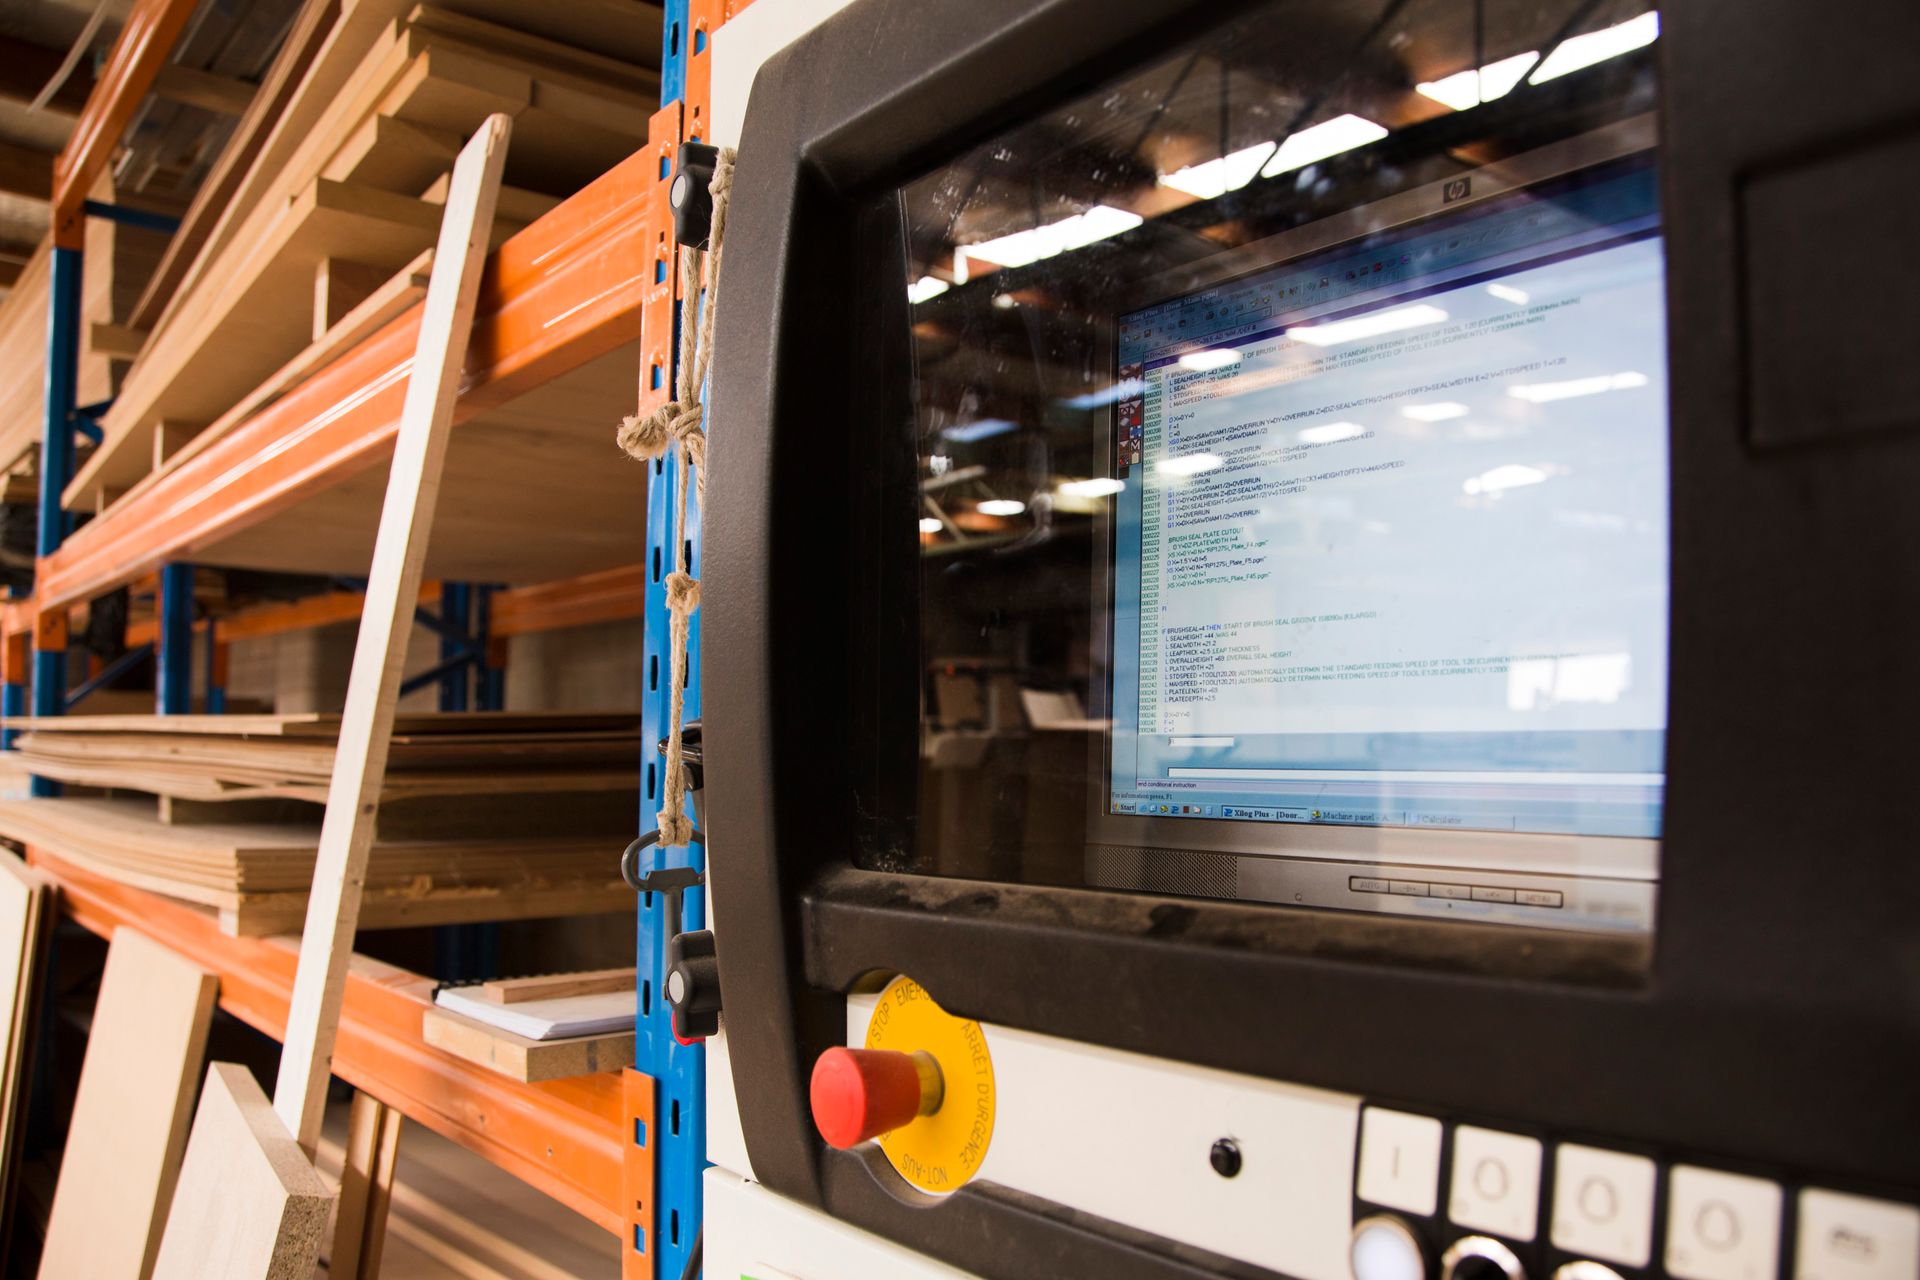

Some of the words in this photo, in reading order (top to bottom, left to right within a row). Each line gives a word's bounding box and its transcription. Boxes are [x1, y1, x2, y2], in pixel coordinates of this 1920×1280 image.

[1174, 371, 1206, 384] SEALHEIGHT
[1203, 530, 1220, 538] PLATE
[1221, 527, 1244, 536] CUTOUT
[1170, 641, 1201, 649] SEALWIDTH
[1228, 645, 1261, 653] THICKNESS
[1170, 656, 1213, 664] OVERALLHEIGHT
[1288, 666, 1320, 674] DETERMIN
[1336, 664, 1372, 672] STANDARD
[1374, 662, 1403, 670] FEEDING
[1441, 659, 1460, 667] TOOL
[1121, 803, 1134, 812] Start
[1235, 809, 1252, 819] Xilog
[1254, 809, 1269, 819] Plus
[1323, 811, 1352, 822] Machine
[1355, 812, 1374, 823] panel
[871, 1002, 890, 1042] STOP
[959, 1083, 990, 1169] D'URGENCE
[901, 1153, 949, 1185] NOT-AUS
